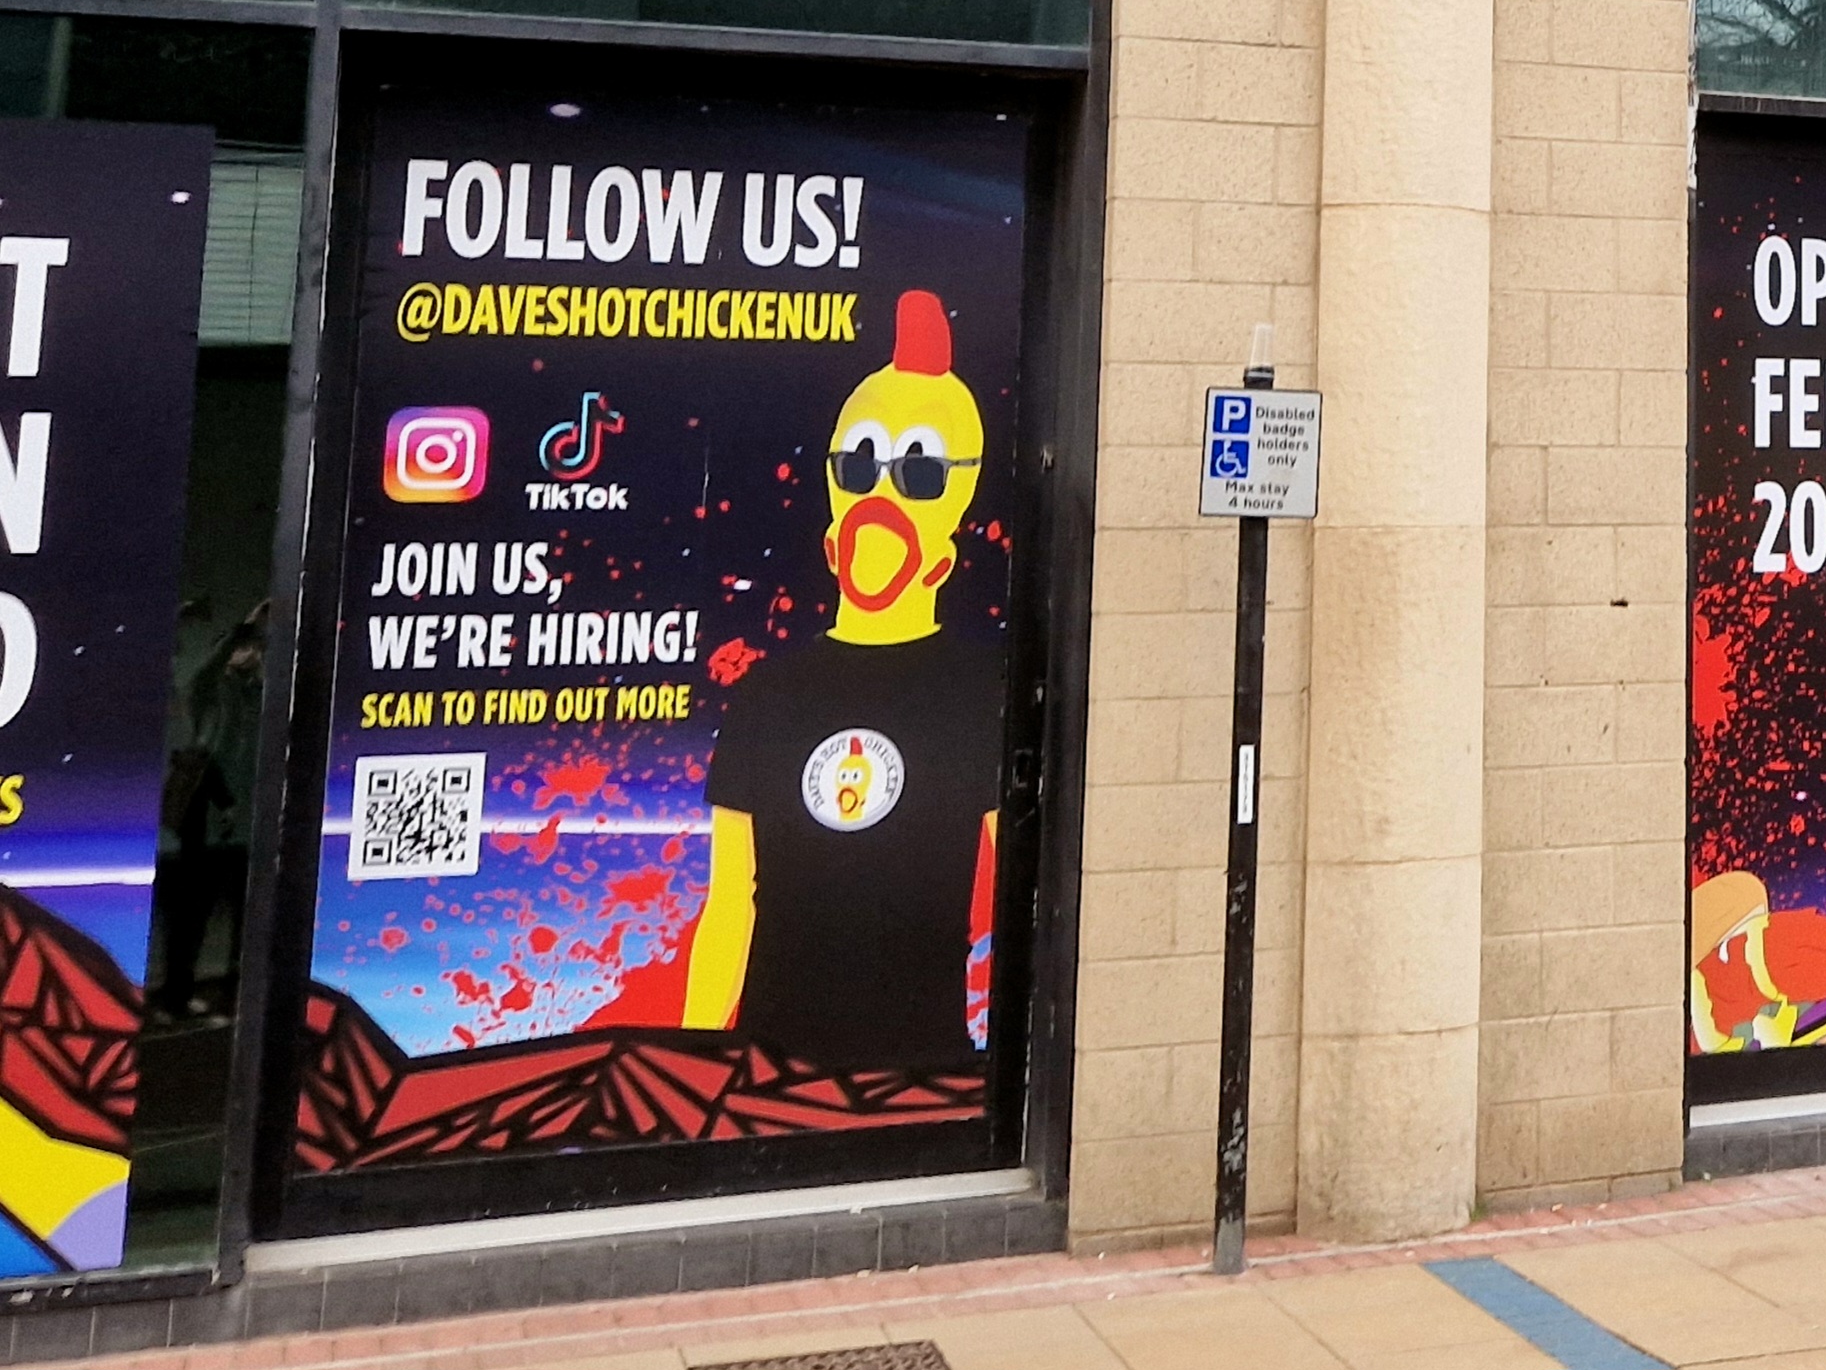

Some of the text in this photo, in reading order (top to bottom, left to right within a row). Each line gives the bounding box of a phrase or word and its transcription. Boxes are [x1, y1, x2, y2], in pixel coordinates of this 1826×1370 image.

[401, 158, 864, 268] FOLLOW US!
[397, 282, 857, 341] @DAVESHOTCHICKENUK
[1255, 406, 1315, 421] Disabled
[1263, 423, 1305, 437] badge
[1257, 438, 1309, 451] holders
[1268, 454, 1297, 467] only
[525, 482, 629, 510] TikTok
[1225, 481, 1290, 495] Max stay
[1229, 497, 1284, 510] 4 hours
[371, 542, 563, 605] JOIN US,
[368, 610, 699, 670] WE'RE HIRING!
[360, 684, 692, 729] SCAN TO FIND OUT MORE
